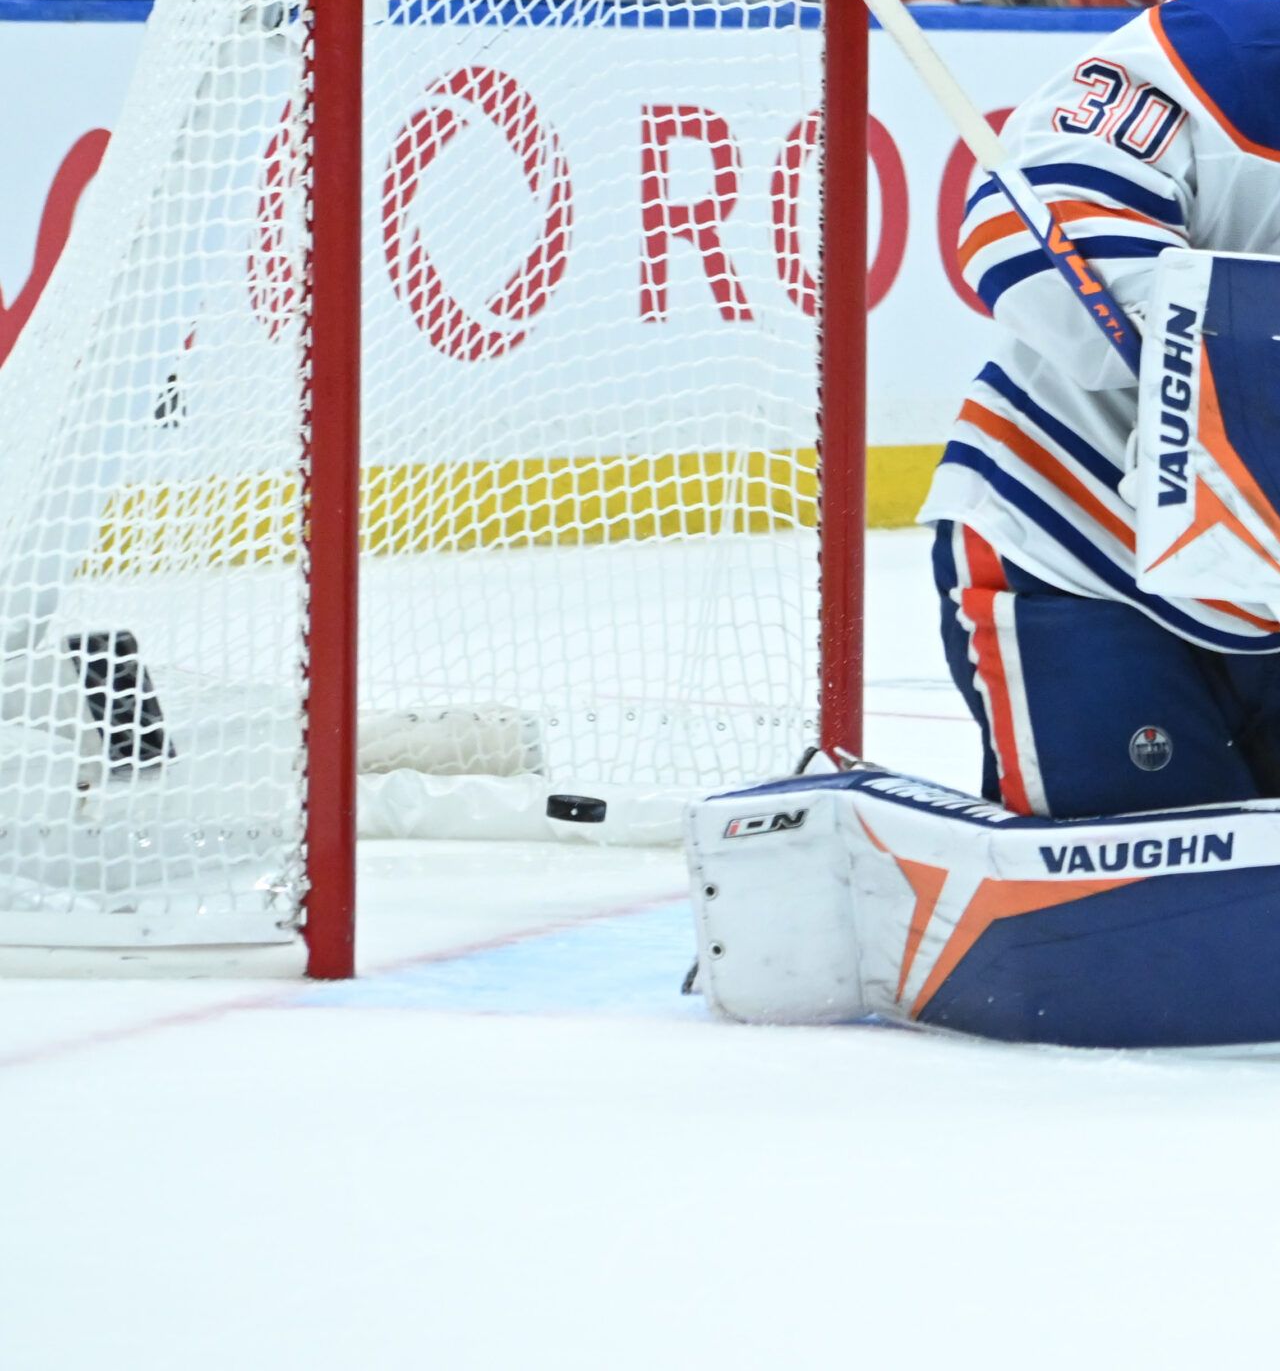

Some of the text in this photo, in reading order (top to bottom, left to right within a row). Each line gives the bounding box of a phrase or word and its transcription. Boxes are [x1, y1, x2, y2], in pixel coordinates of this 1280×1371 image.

[1052, 57, 1190, 164] 30
[1157, 303, 1198, 508] VAUGHN
[1039, 832, 1234, 874] VAUGHN
